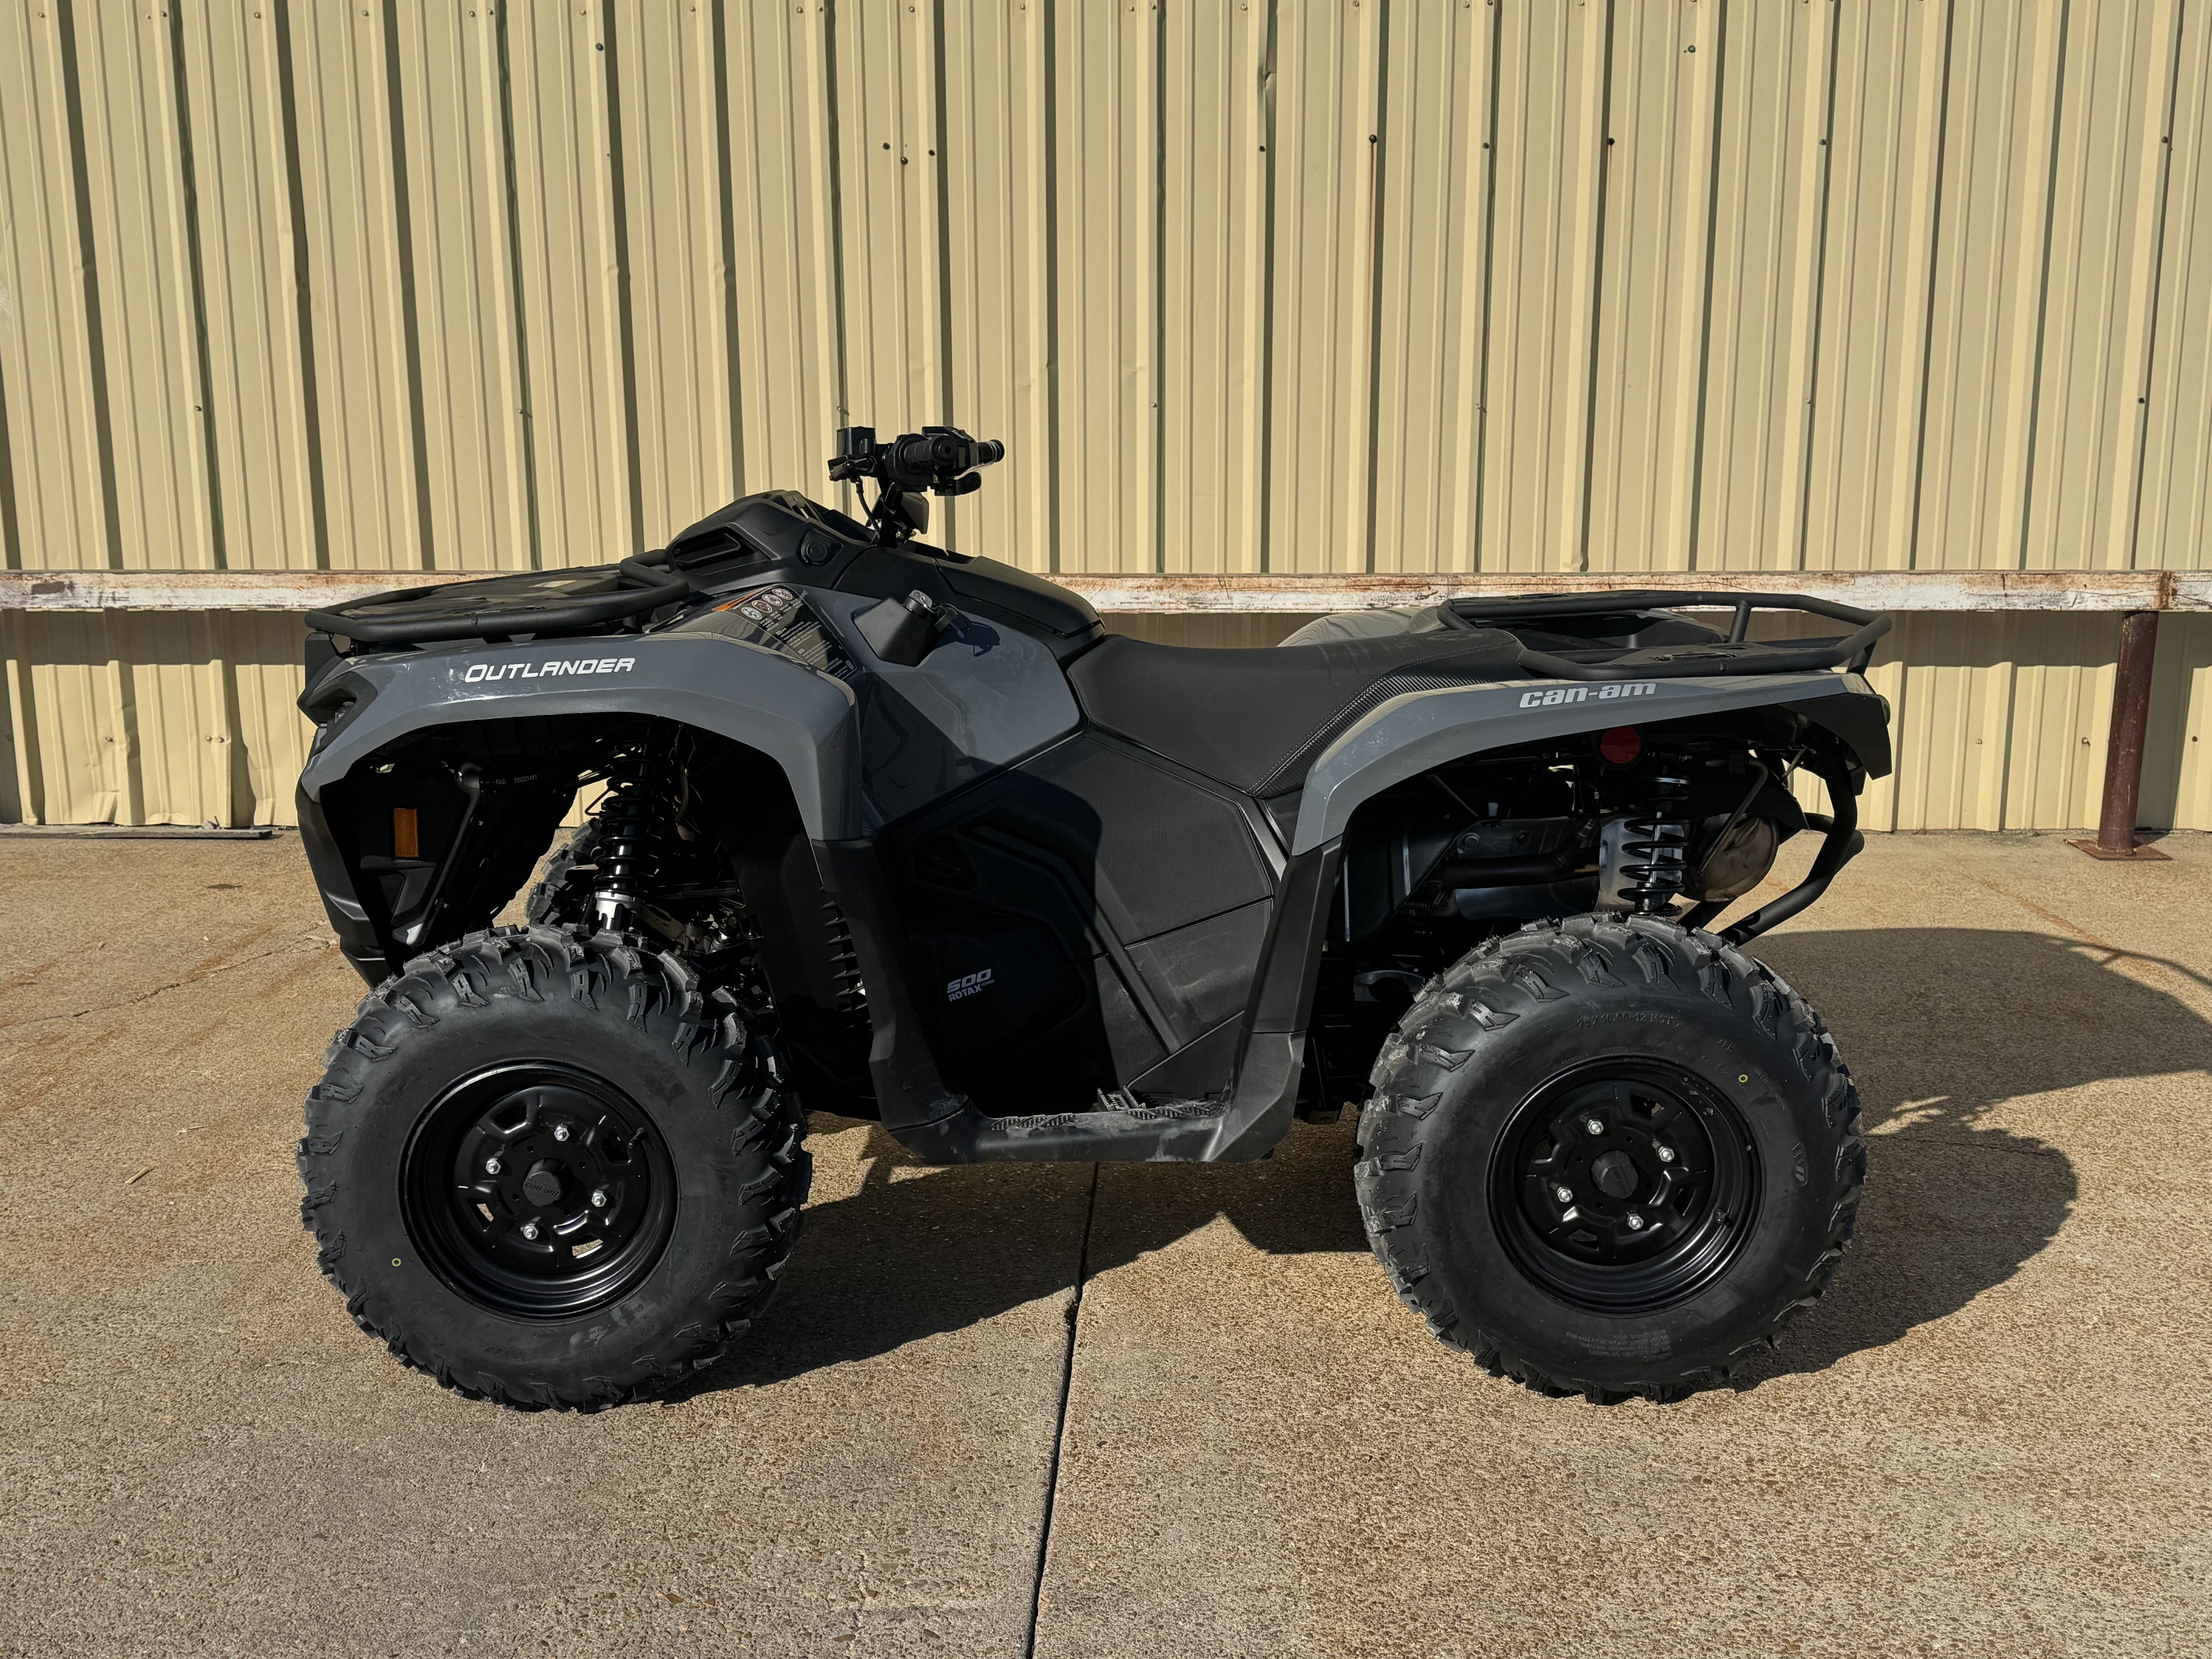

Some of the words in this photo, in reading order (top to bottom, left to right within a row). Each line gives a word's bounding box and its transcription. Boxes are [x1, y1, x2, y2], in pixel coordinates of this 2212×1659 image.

[465, 658, 635, 683] OUTLANDER
[1519, 683, 1656, 708] can-am
[947, 969, 991, 993] 500
[948, 984, 982, 1002] ROTAX
